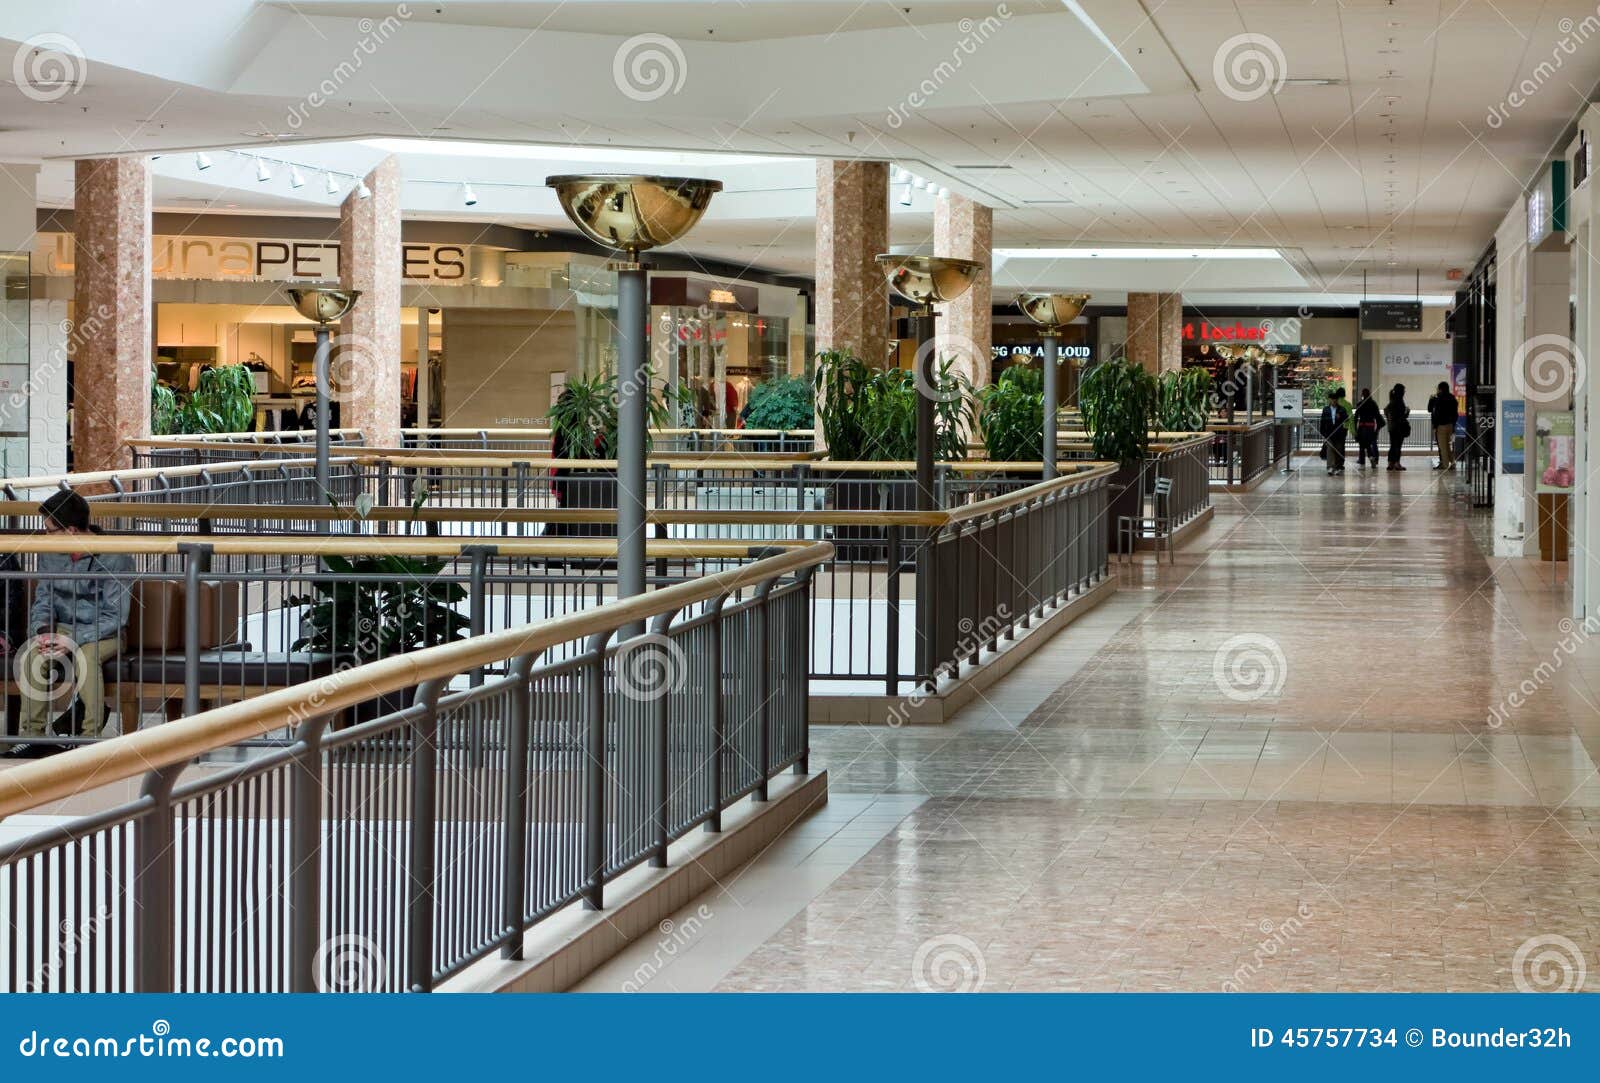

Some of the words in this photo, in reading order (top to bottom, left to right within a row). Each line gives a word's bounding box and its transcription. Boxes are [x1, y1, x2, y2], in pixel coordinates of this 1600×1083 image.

[1200, 321, 1265, 340] Locker
[1012, 346, 1032, 356] ON
[1058, 346, 1090, 357] LOUD
